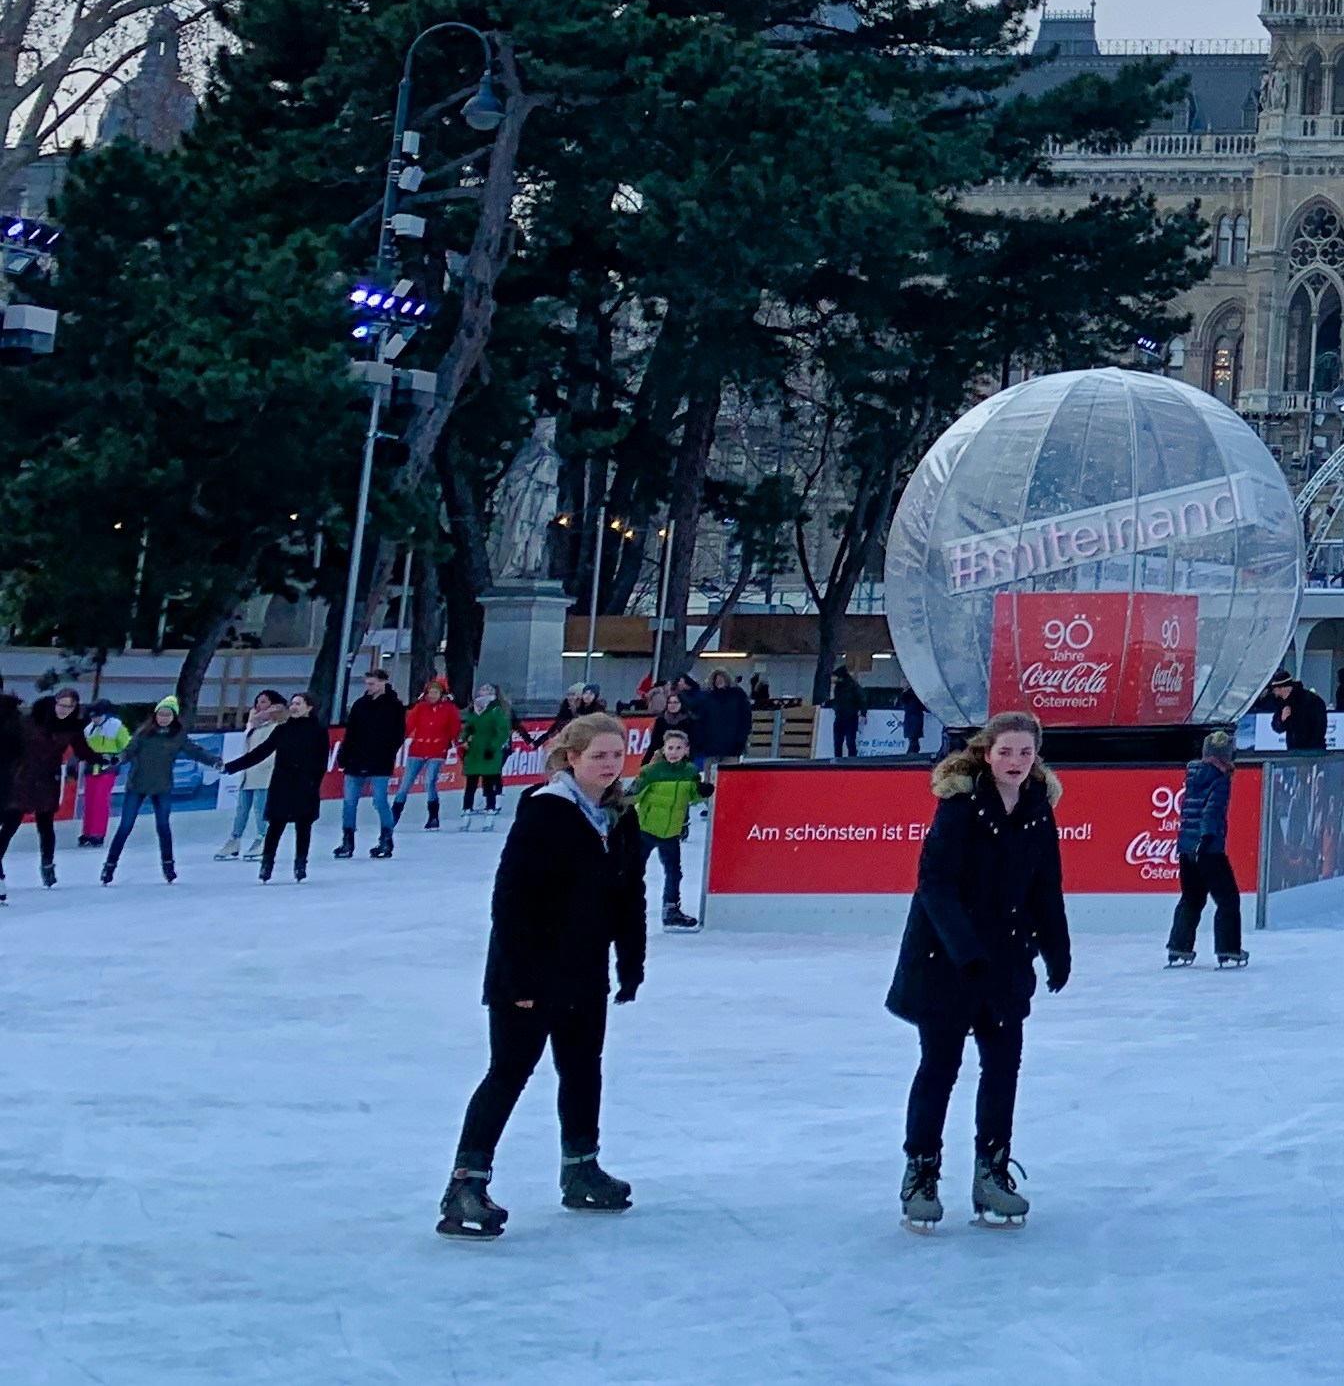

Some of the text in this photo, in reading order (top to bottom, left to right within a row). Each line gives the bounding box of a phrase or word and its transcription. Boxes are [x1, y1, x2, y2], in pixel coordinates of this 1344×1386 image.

[1050, 648, 1085, 663] Jahre
[1019, 661, 1114, 694] Coca-Cola
[1033, 693, 1098, 708] Österreich
[747, 823, 779, 841] Am
[784, 822, 877, 841] schönsten
[881, 823, 903, 841] ist
[1157, 818, 1181, 833] Jah
